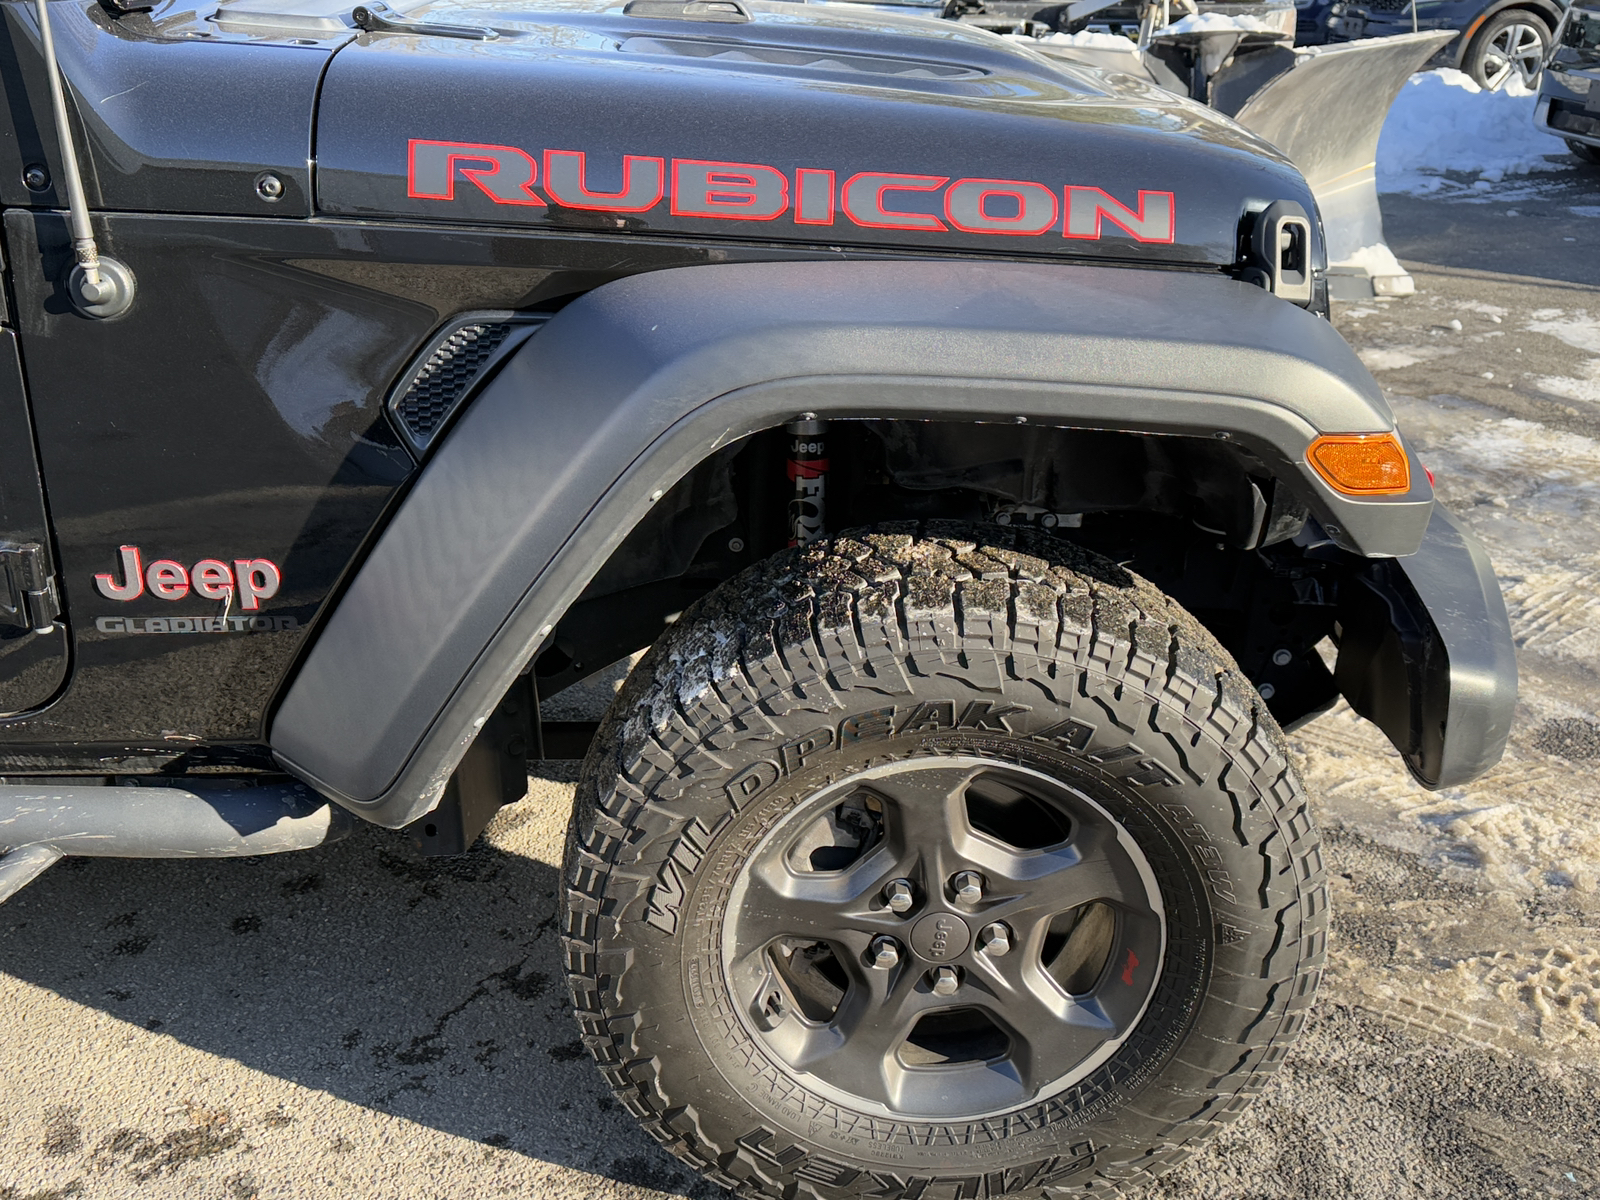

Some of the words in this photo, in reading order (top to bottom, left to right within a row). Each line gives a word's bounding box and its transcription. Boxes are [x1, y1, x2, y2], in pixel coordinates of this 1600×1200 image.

[408, 139, 1175, 243] RUBICON
[790, 439, 825, 455] Jeep
[94, 545, 281, 610] Jeep
[95, 615, 300, 634] GLADIATOR
[645, 698, 1034, 935] WILDPEAK
[1156, 803, 1237, 905] AT3W
[928, 919, 953, 957] Jeep
[760, 1090, 782, 1110] RANGE
[782, 1107, 803, 1122] LOAD
[829, 1131, 860, 1146] M+S
[868, 1141, 905, 1153] TUBELESS
[734, 1124, 1110, 1200] FALKEN
